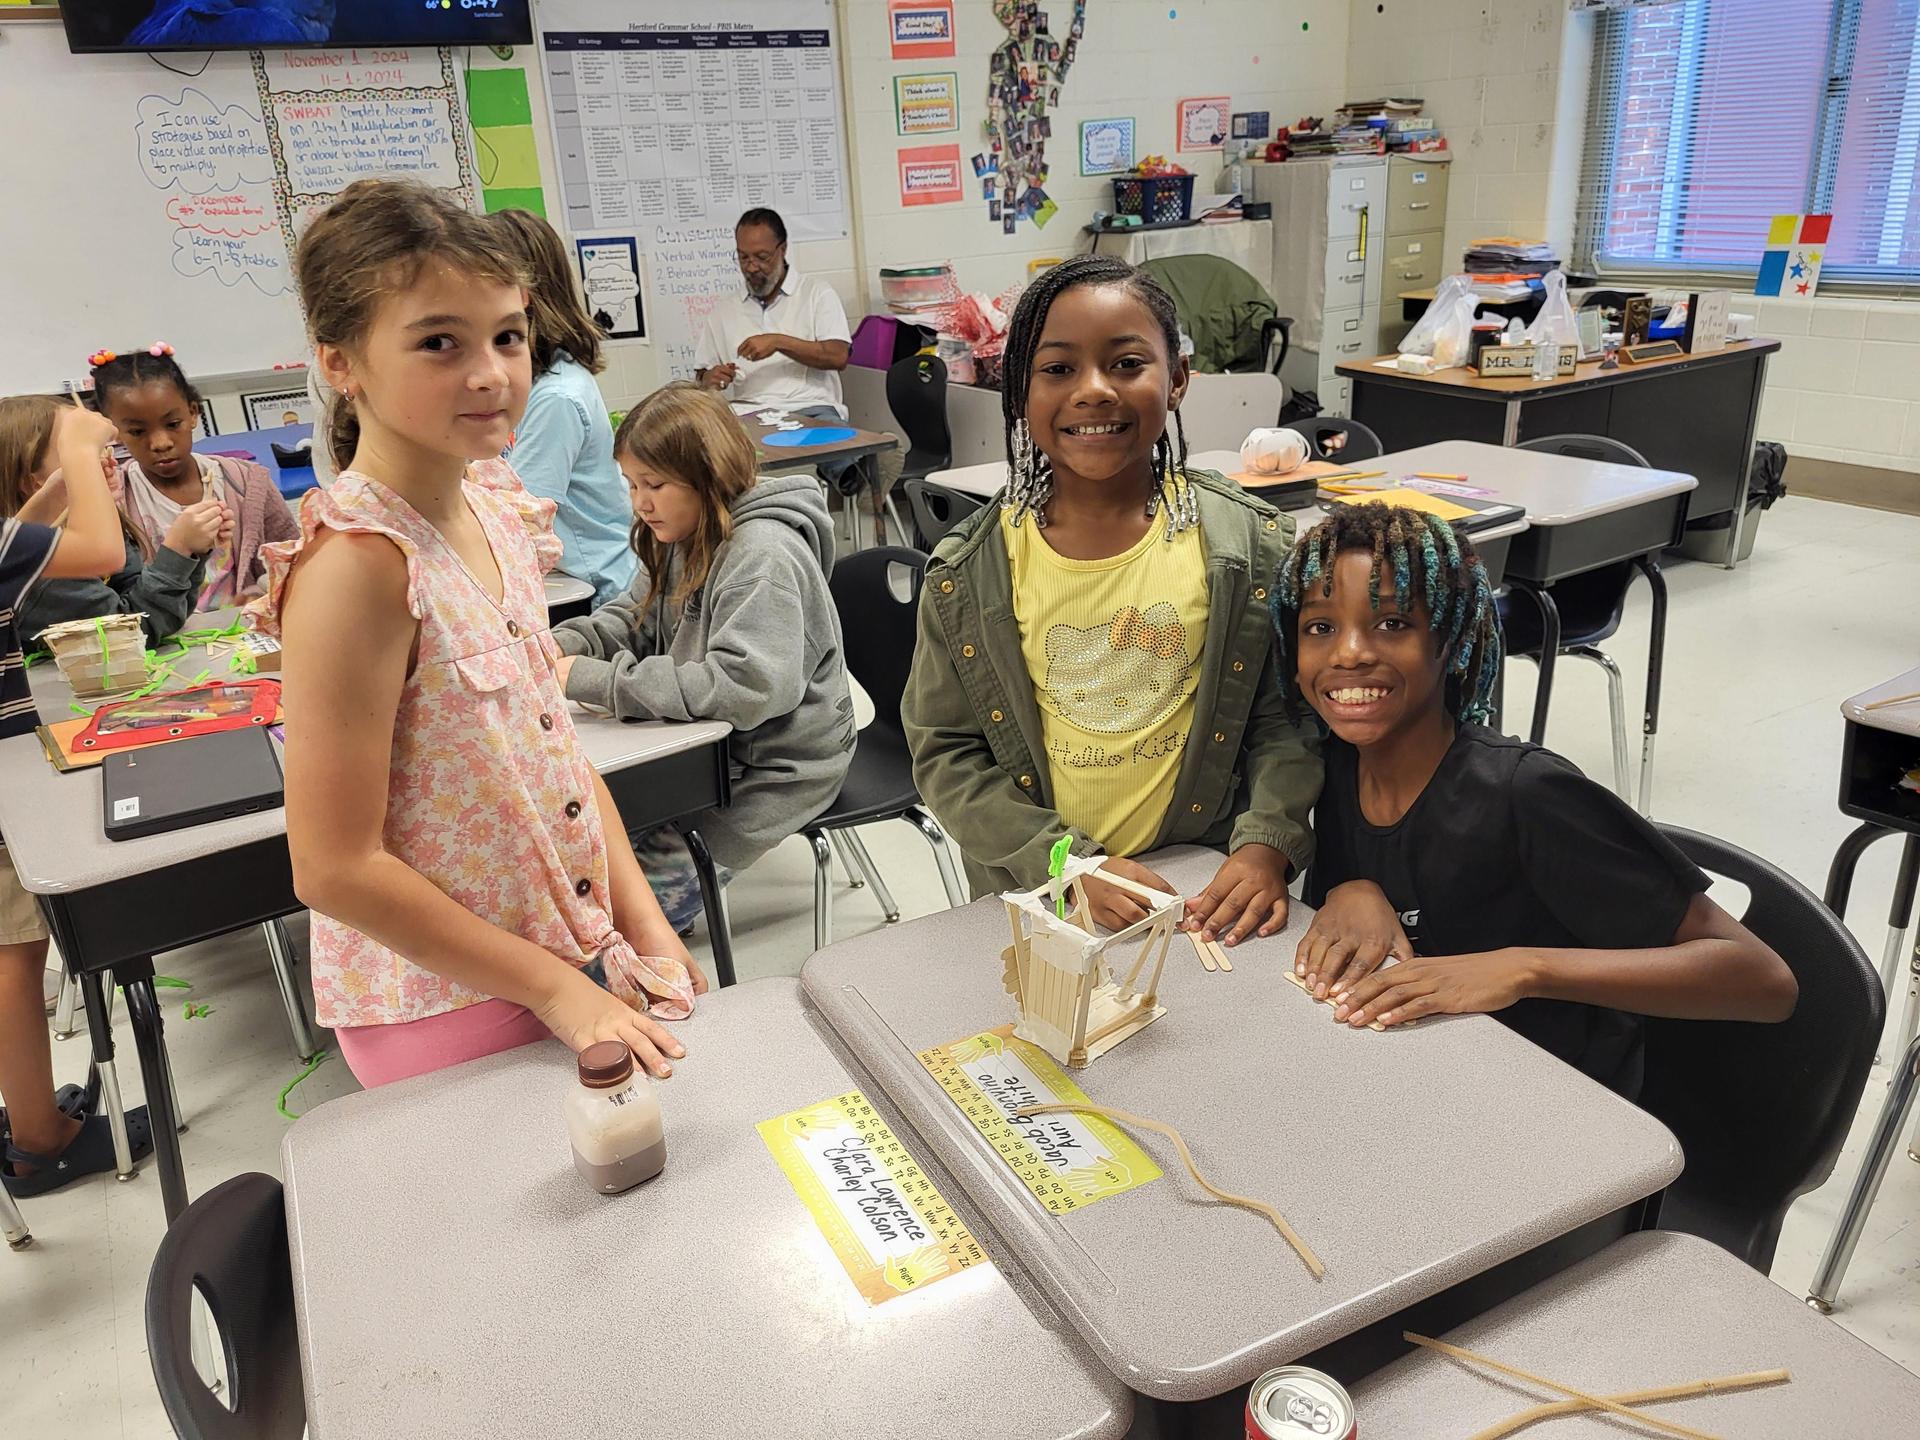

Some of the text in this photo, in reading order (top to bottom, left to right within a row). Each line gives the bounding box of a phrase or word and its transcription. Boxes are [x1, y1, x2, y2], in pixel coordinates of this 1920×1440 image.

[628, 22, 657, 31] Hertford
[659, 22, 689, 31] Grammar
[691, 22, 712, 31] School
[733, 22, 754, 31] Matrix
[284, 50, 411, 68] November 1 2024
[283, 101, 434, 121] SWBAT Complete Assessment
[157, 112, 221, 127] I can use
[205, 123, 233, 140] based
[238, 128, 251, 138] on
[290, 125, 305, 137] on
[351, 120, 418, 135] Multiplication
[293, 137, 313, 151] goal
[149, 147, 176, 164] place
[177, 146, 205, 158] value
[154, 159, 167, 174] to
[189, 231, 221, 248] Learn
[243, 256, 279, 268] tables
[661, 250, 695, 262] Verbal
[666, 265, 711, 279] Behavior
[671, 283, 697, 294] Loss
[699, 280, 711, 295] of
[1050, 738, 1125, 768] Hello
[922, 1053, 933, 1065] Mm
[931, 1067, 943, 1075] Ll
[940, 1076, 952, 1086] Kk
[967, 1105, 980, 1117] Hh
[931, 1048, 1077, 1209] Nn Oo Pp Qq Rr Ss Tt Uu Vv Ww Xx Yy Zz
[978, 1118, 990, 1129] Gg
[987, 1132, 1000, 1141] Ff
[1041, 1121, 1082, 1148] Auri
[1000, 1143, 1011, 1154] Ee
[1022, 1129, 1069, 1167] Jacob
[1009, 1156, 1024, 1168] Dd
[838, 1096, 971, 1269] Nn Oo Pp Qq Rr Ss Tt Uu Vv Ww Xx Yy Zz
[851, 1095, 861, 1104] Aa
[860, 1105, 871, 1116] Bb
[870, 1118, 880, 1127] Cc
[878, 1129, 892, 1140] Dd
[888, 1142, 899, 1152] Ee
[897, 1154, 911, 1163] Ff
[906, 1166, 918, 1178] Gg
[916, 1179, 929, 1192] Hh
[935, 1205, 948, 1213] Jj
[944, 1215, 957, 1228] Kk
[956, 1230, 969, 1240] Ll
[965, 1243, 982, 1260] Mm
[1023, 1170, 1035, 1181] Cc
[823, 1148, 898, 1242] Charley Colson
[842, 1137, 925, 1241] Clara Lawrence
[1035, 1184, 1048, 1196] Bb
[1048, 1199, 1062, 1211] Aa
[899, 1267, 915, 1286] Right
